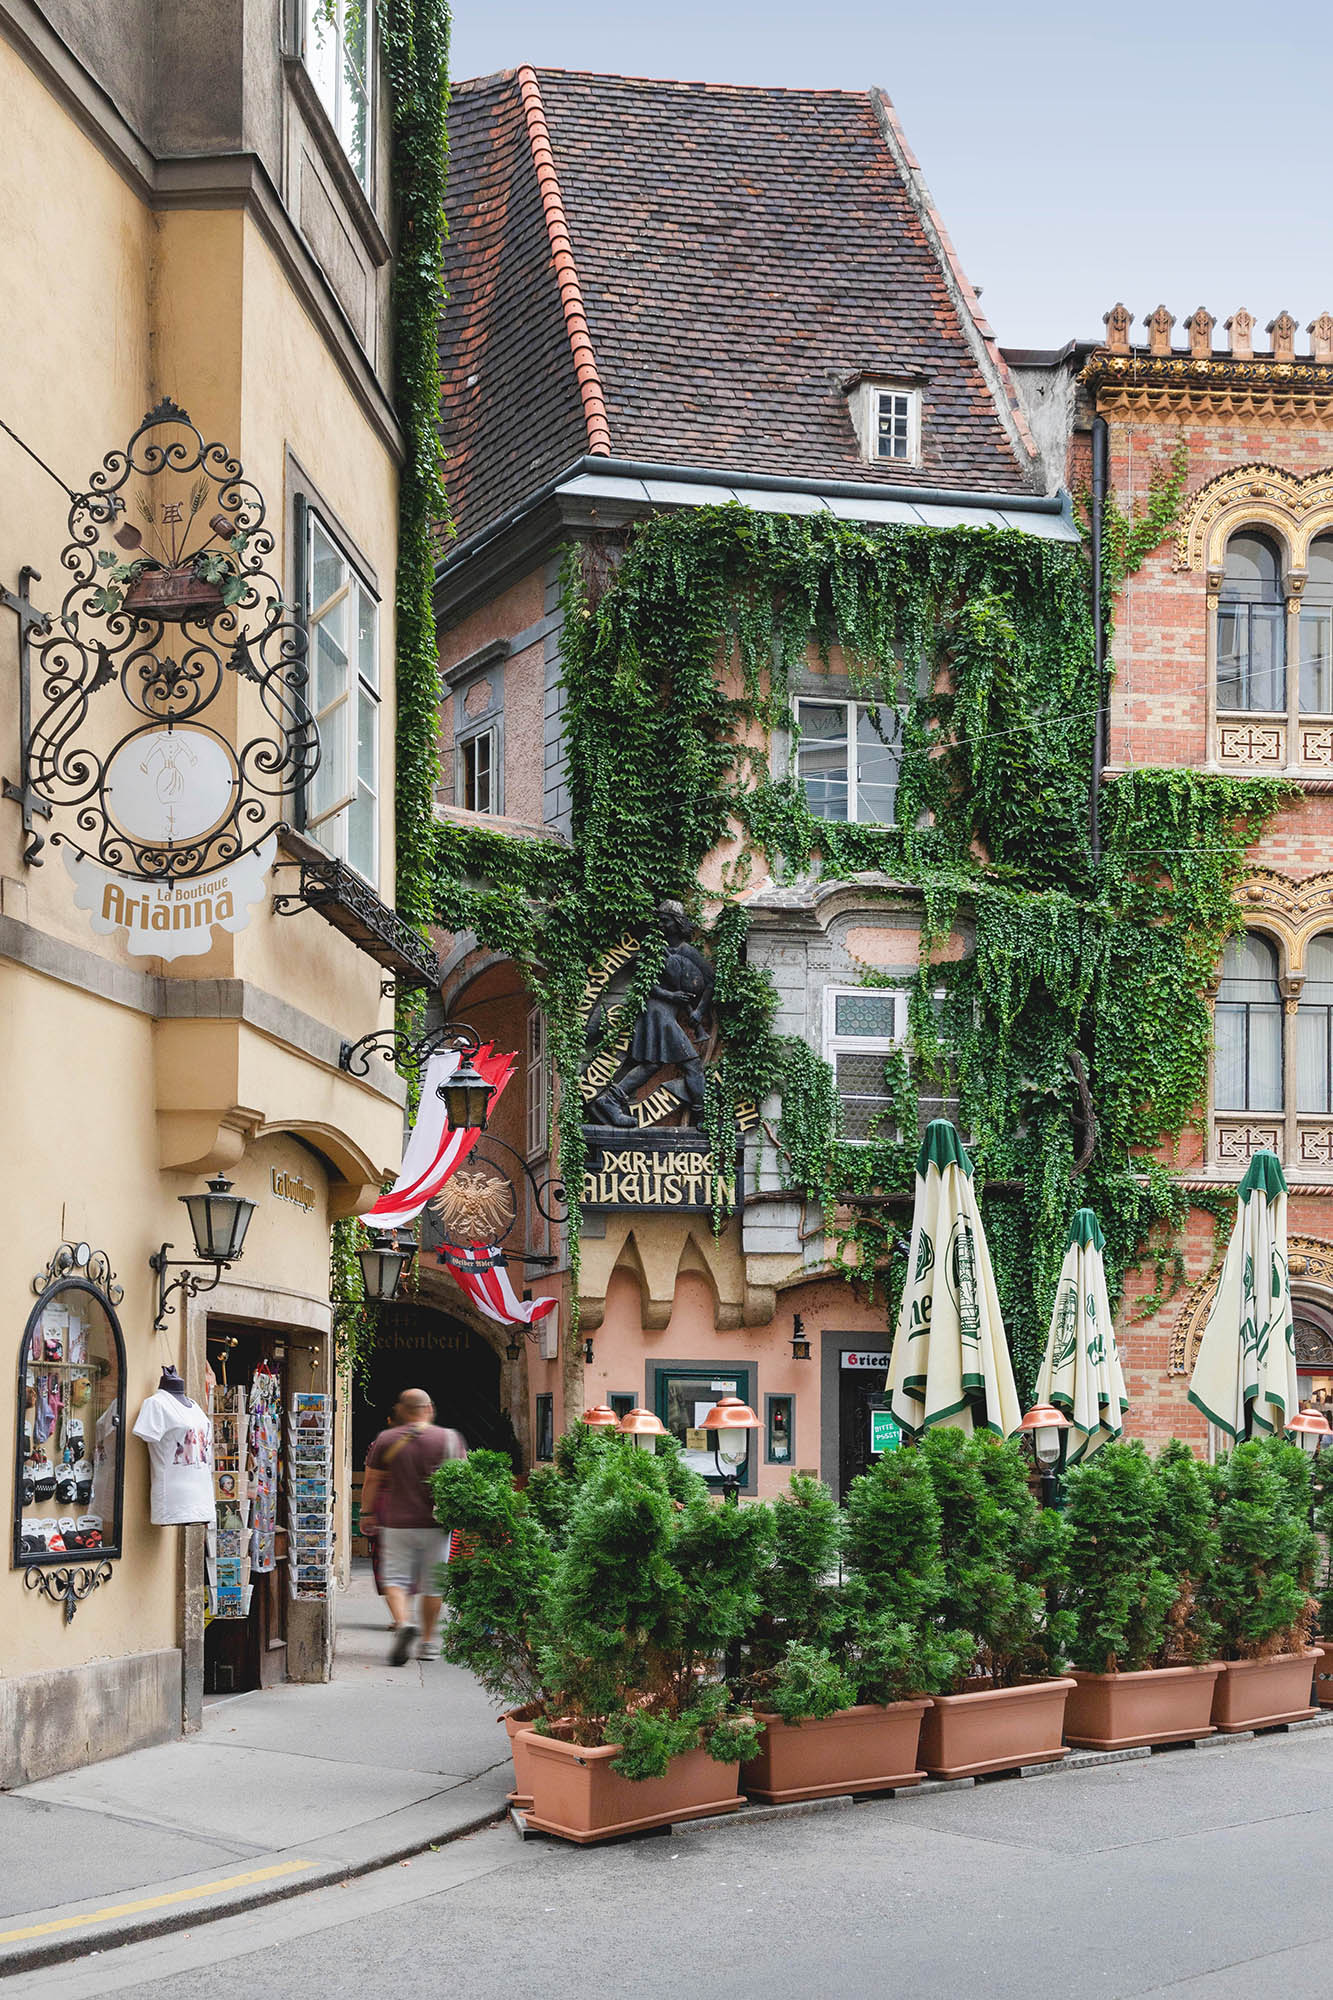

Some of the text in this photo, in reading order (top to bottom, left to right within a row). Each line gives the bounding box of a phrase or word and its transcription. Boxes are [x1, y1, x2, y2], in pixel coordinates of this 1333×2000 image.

[101, 882, 234, 931] Arianna
[157, 877, 228, 902] La Boutique
[577, 1051, 622, 1104] SEIN
[629, 1087, 681, 1129] ZUM
[271, 1166, 284, 1201] La
[578, 1172, 736, 1206] AUGUSTIN
[874, 1423, 893, 1433] BITTE
